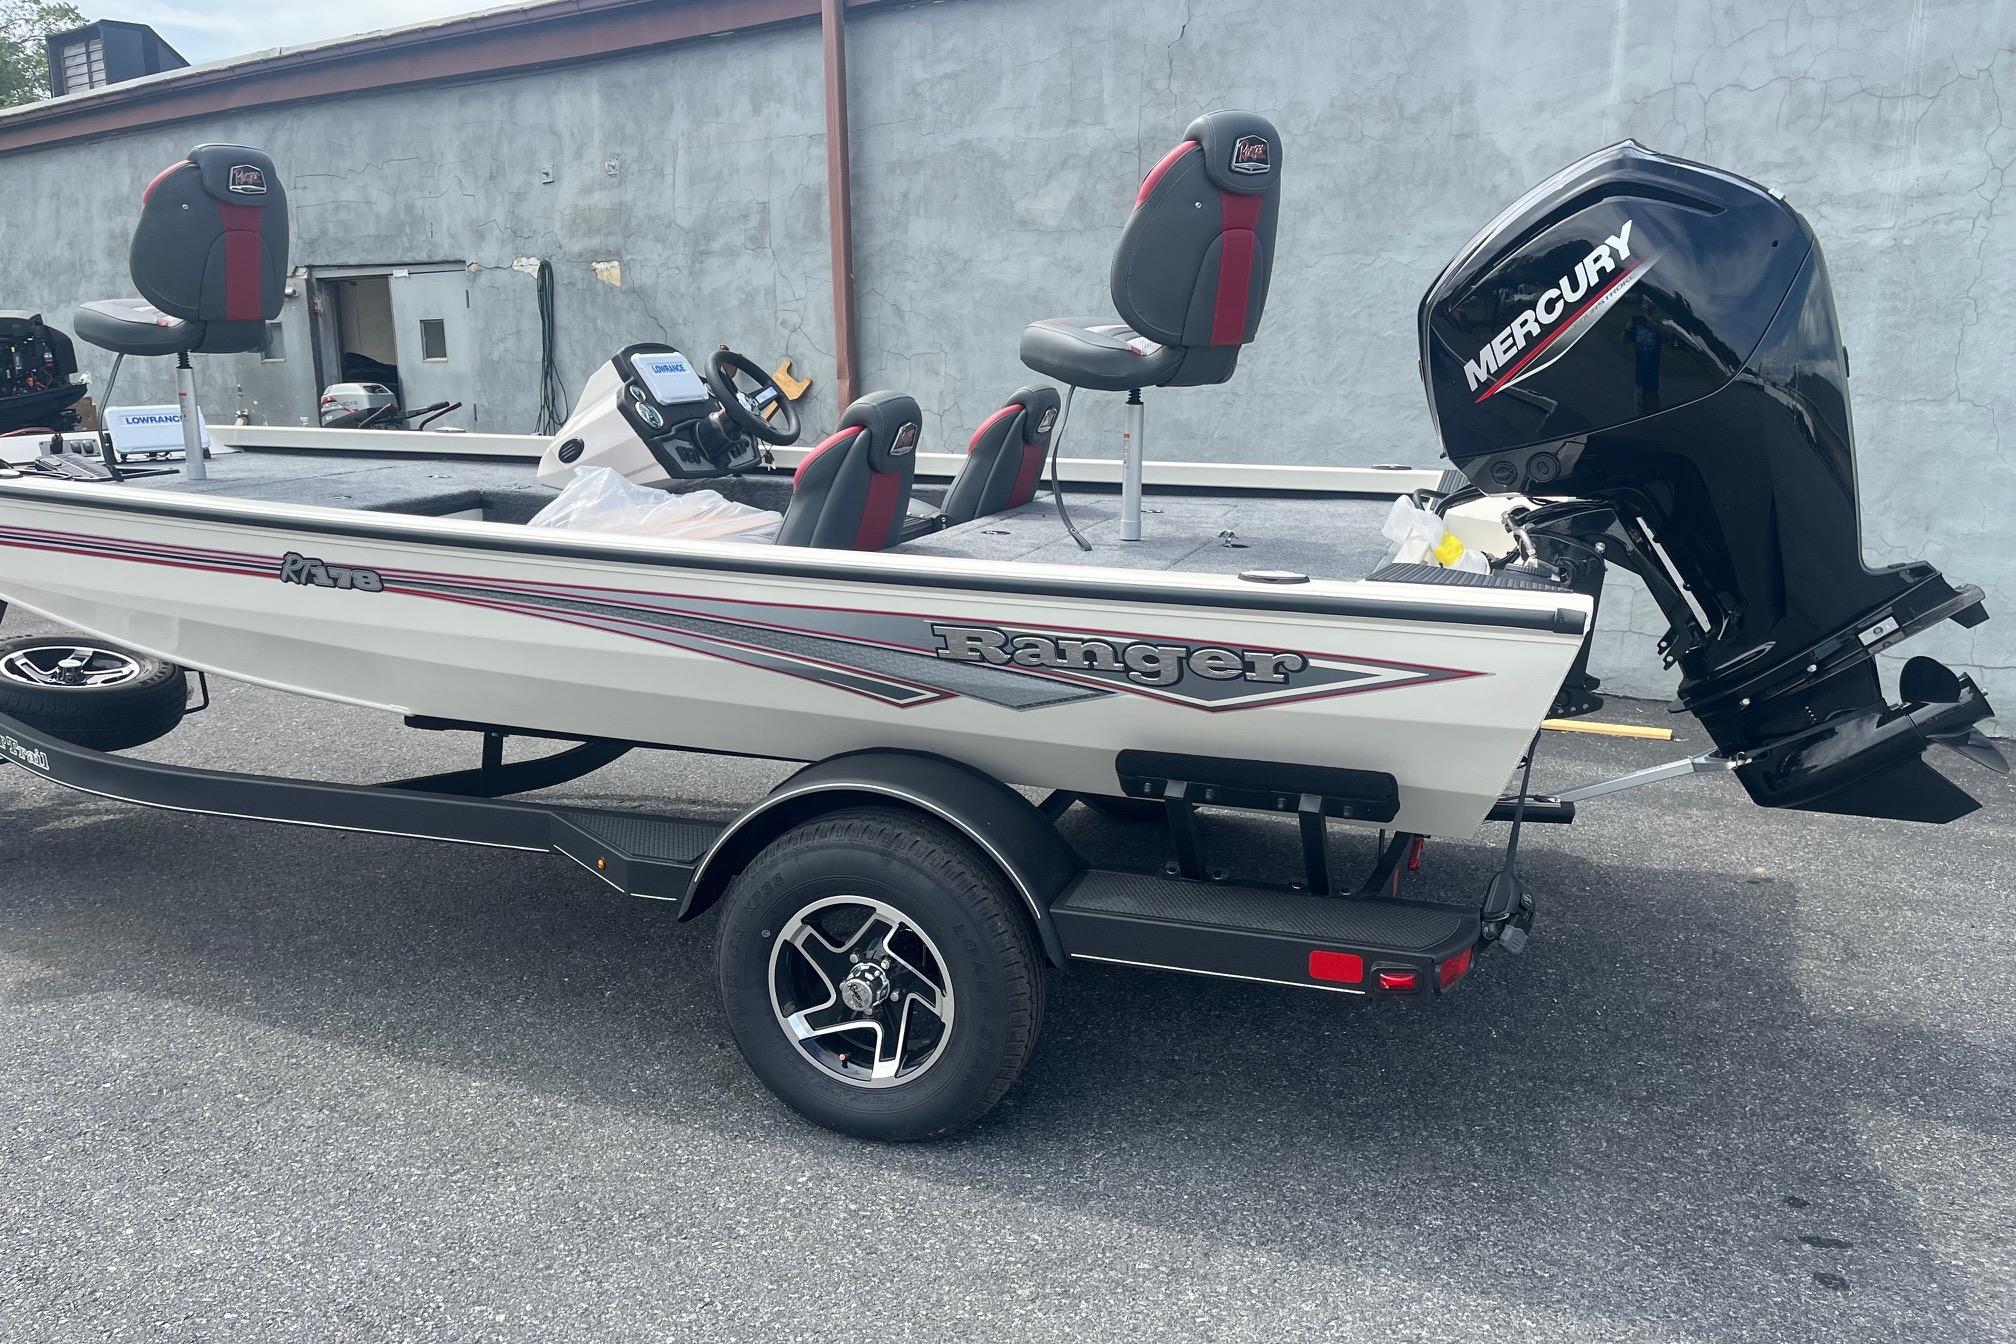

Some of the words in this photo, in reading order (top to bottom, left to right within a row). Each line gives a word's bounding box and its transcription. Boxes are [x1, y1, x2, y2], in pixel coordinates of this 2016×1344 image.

[1464, 219, 1633, 392] MERCURY
[651, 364, 687, 373] LOWRANCE
[280, 551, 384, 593] RT178
[931, 622, 1309, 687] Ranger
